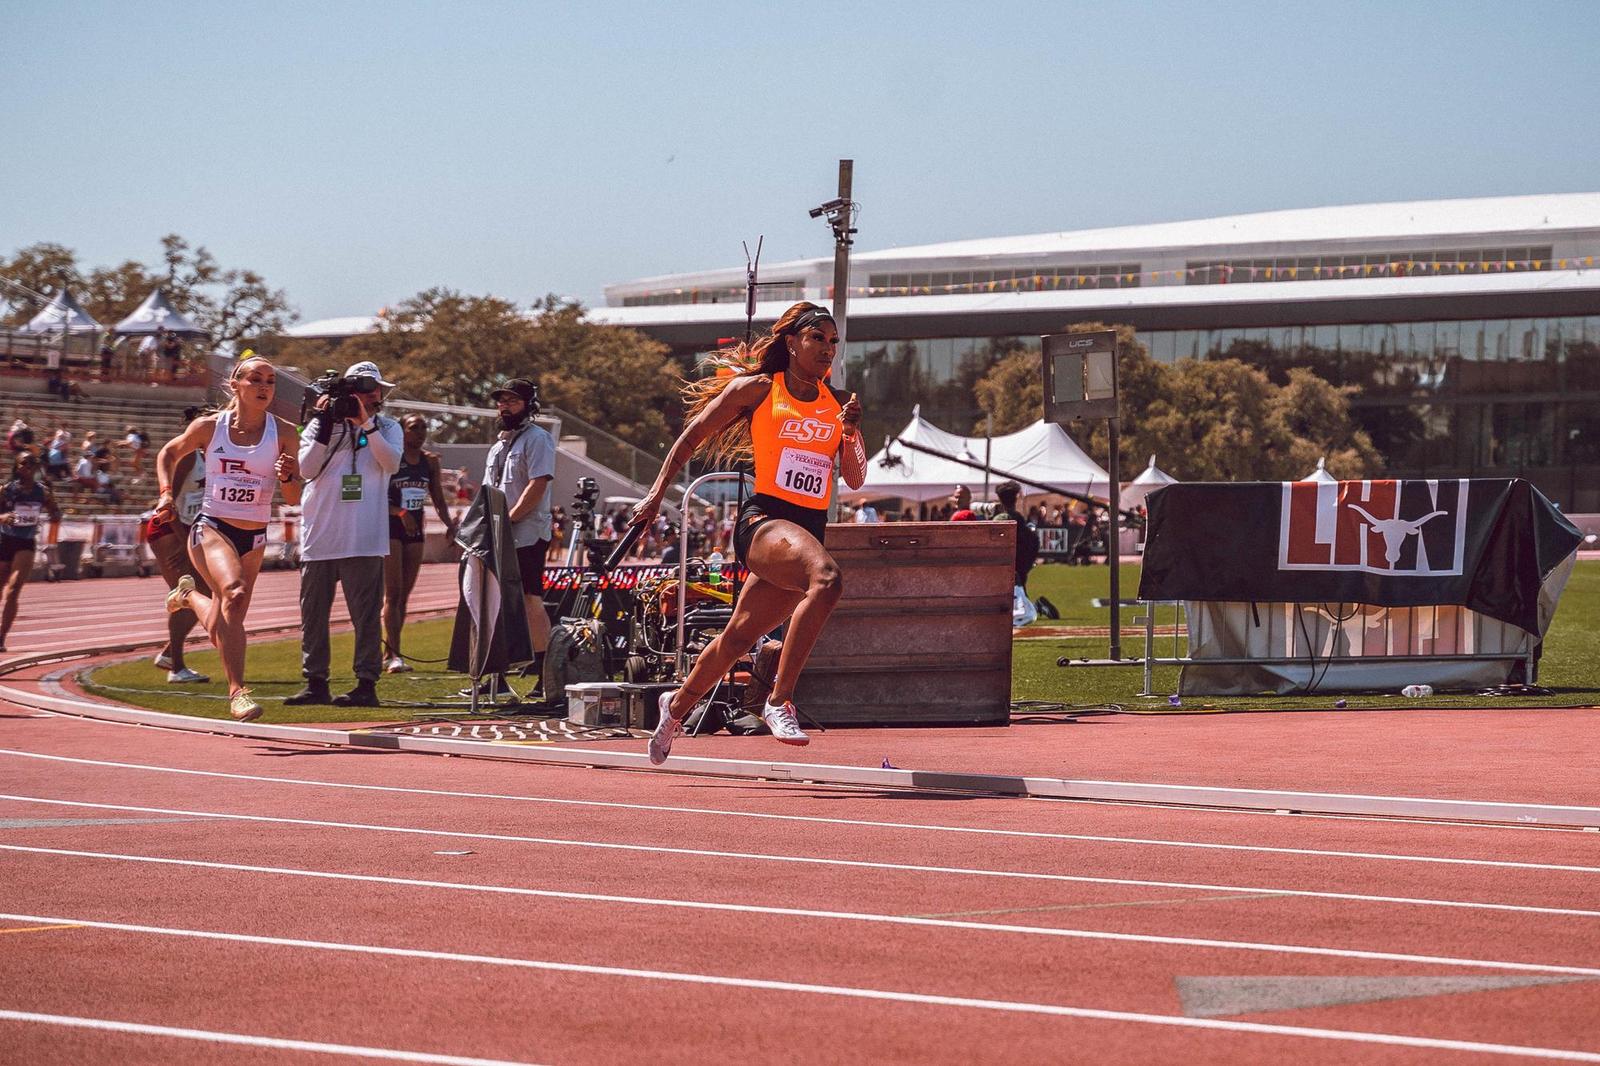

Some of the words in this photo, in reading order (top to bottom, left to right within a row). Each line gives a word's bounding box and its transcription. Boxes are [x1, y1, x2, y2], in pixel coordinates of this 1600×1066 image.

[1069, 339, 1094, 348] UCS
[778, 418, 835, 443] OSU
[785, 469, 822, 494] 1603
[220, 487, 255, 502] 1325
